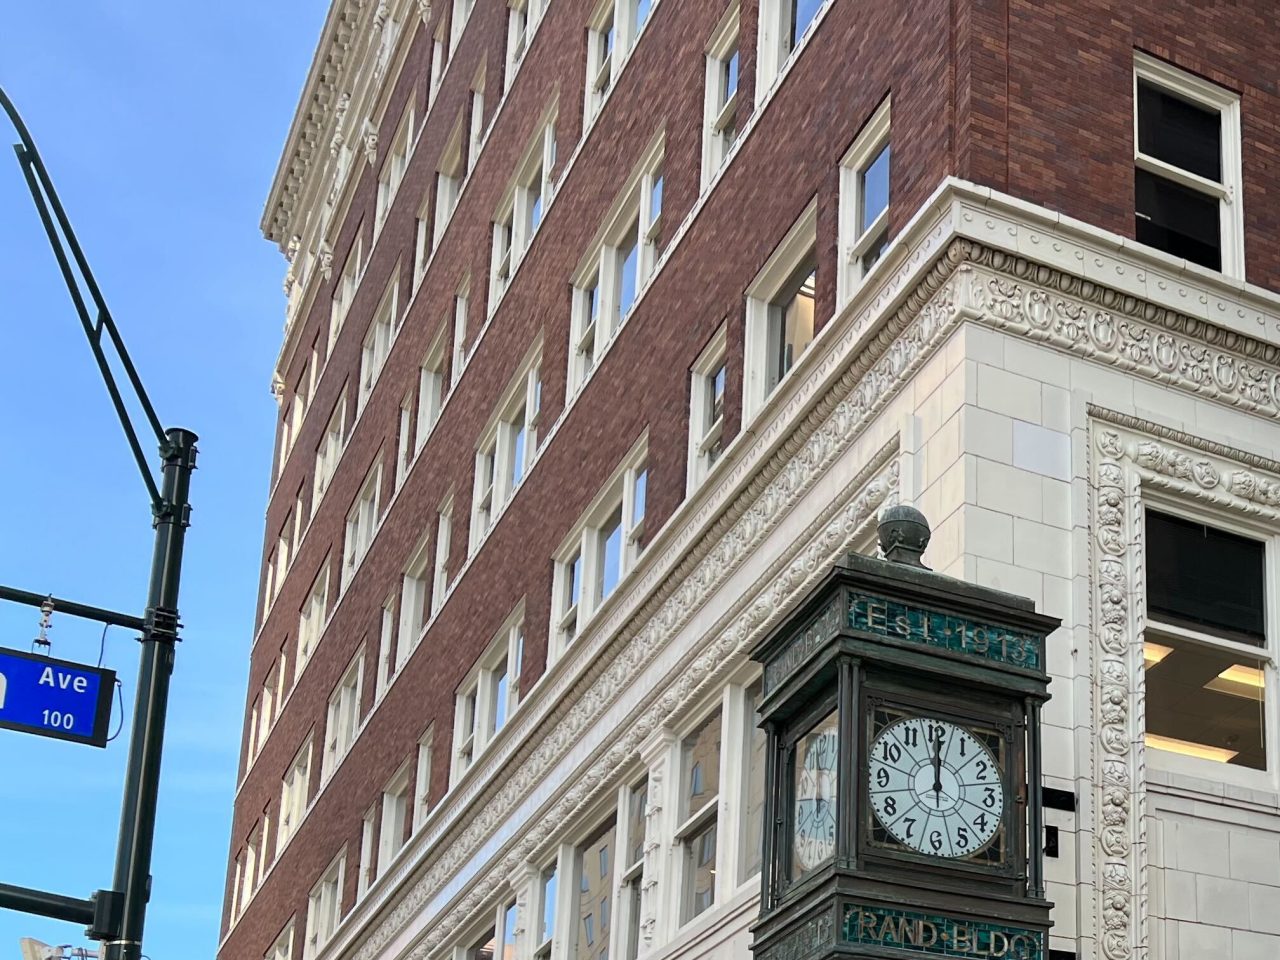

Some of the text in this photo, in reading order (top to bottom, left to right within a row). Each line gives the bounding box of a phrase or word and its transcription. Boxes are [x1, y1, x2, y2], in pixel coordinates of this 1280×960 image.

[955, 624, 1027, 662] 1913
[38, 667, 88, 693] Ave
[42, 709, 74, 730] 100
[904, 726, 918, 748] 11
[959, 737, 966, 757] 1
[882, 740, 902, 764] 10
[877, 767, 890, 788] 9
[975, 760, 988, 780] 2
[884, 796, 897, 816] 8
[982, 787, 996, 808] 3
[903, 817, 917, 838] 7
[973, 812, 988, 833] 4
[929, 830, 943, 851] 6
[956, 827, 969, 848] 5
